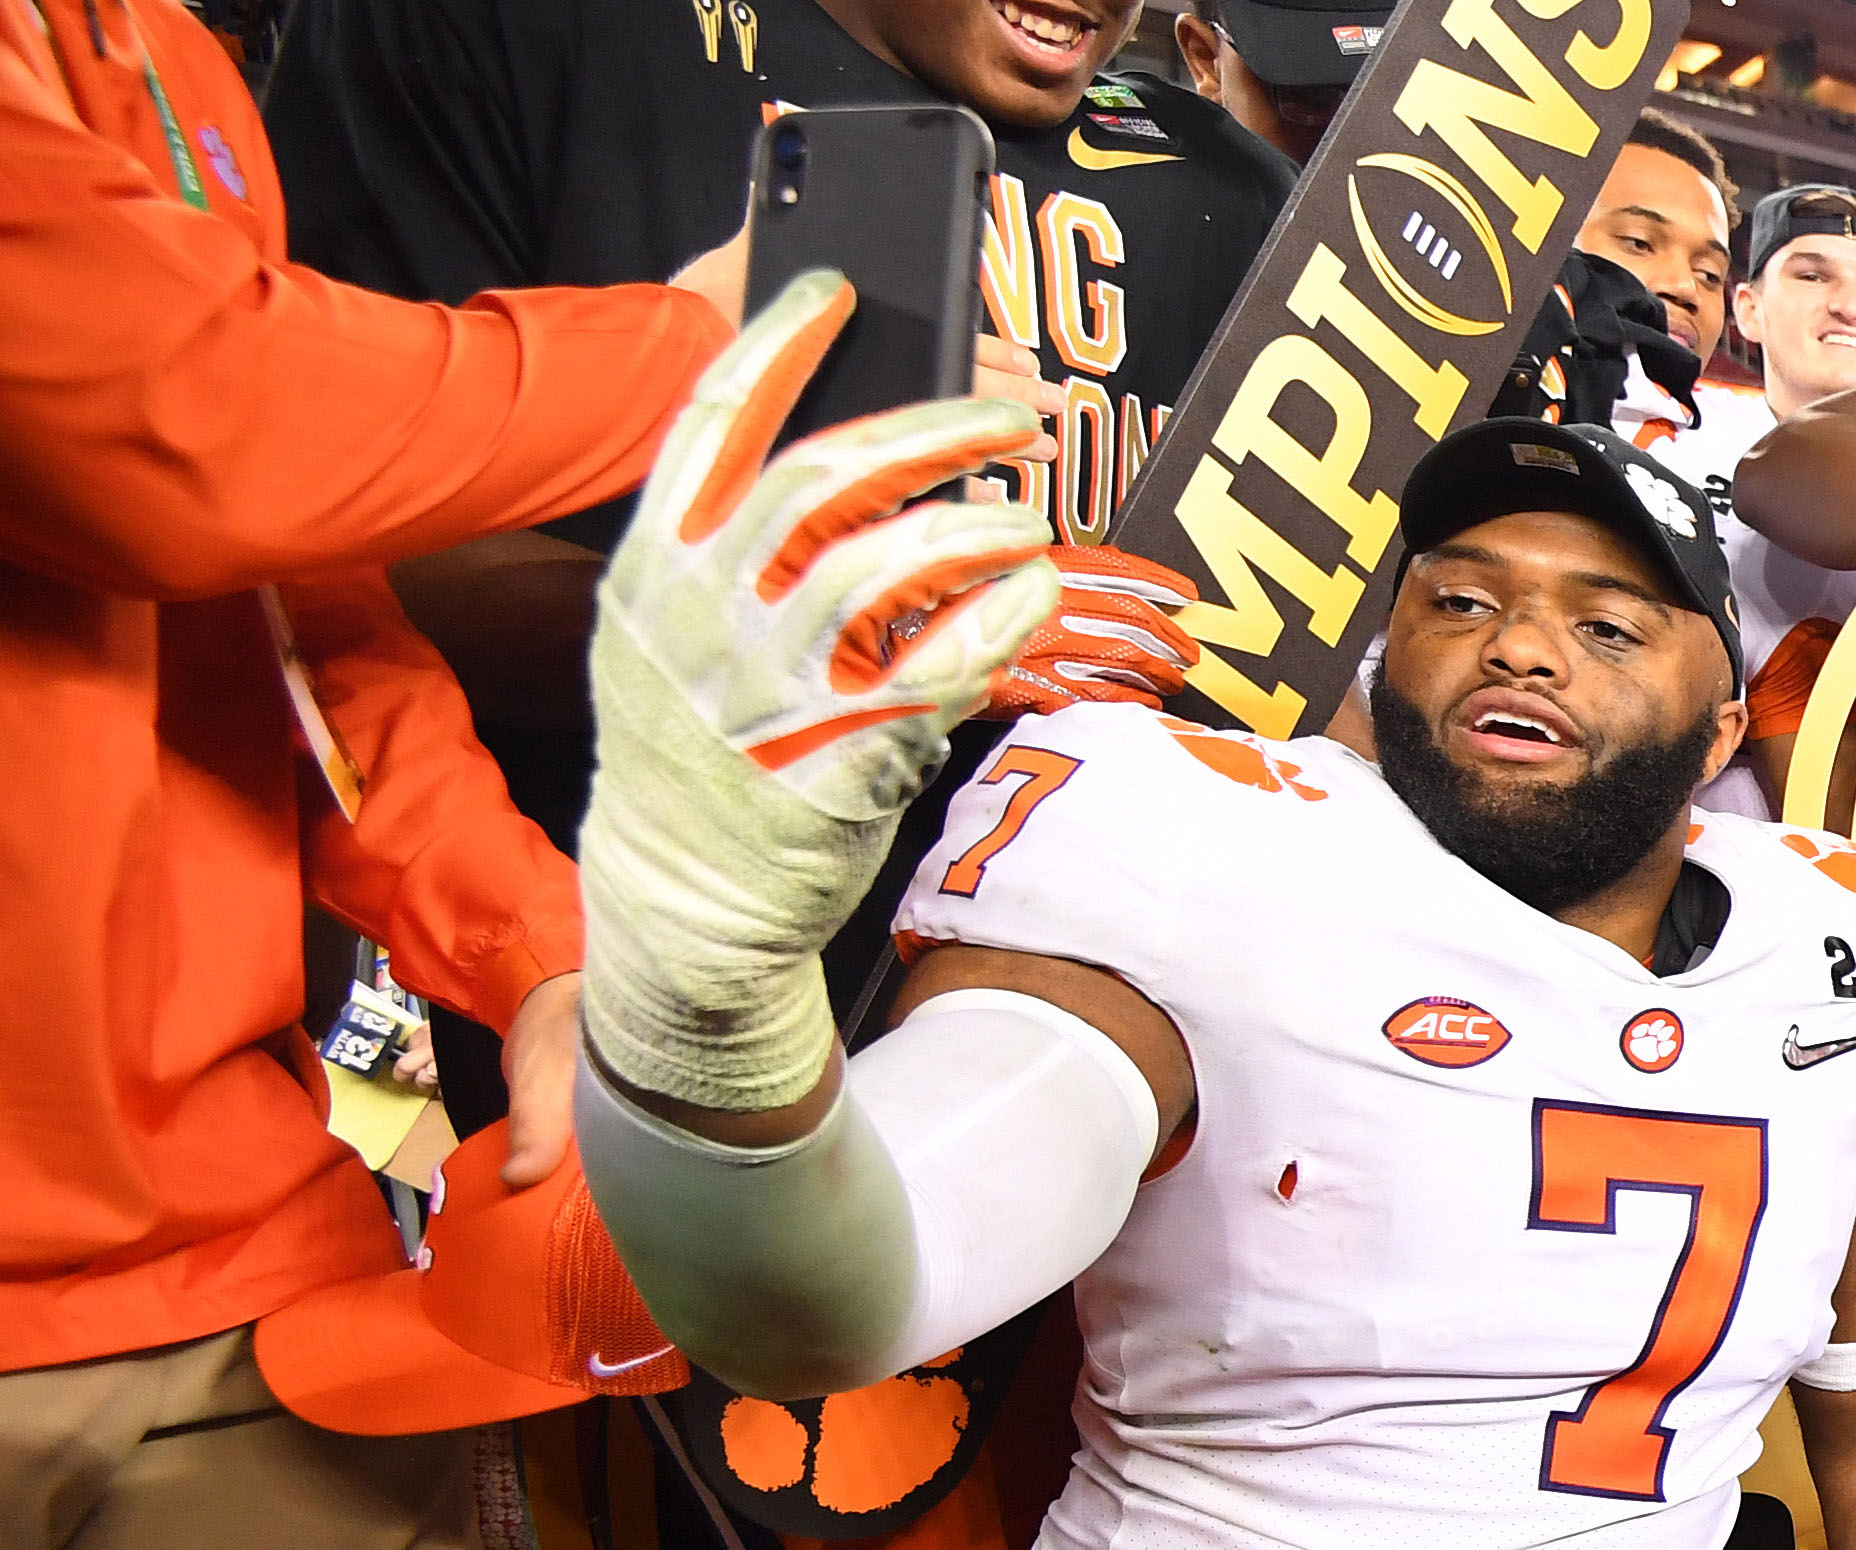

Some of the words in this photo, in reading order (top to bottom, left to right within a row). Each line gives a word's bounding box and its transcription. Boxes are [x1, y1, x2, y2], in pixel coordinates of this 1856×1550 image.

[982, 172, 1127, 378] NG
[938, 744, 1085, 900] 7
[1399, 1011, 1495, 1042] ACC
[1525, 1097, 1770, 1502] 7
